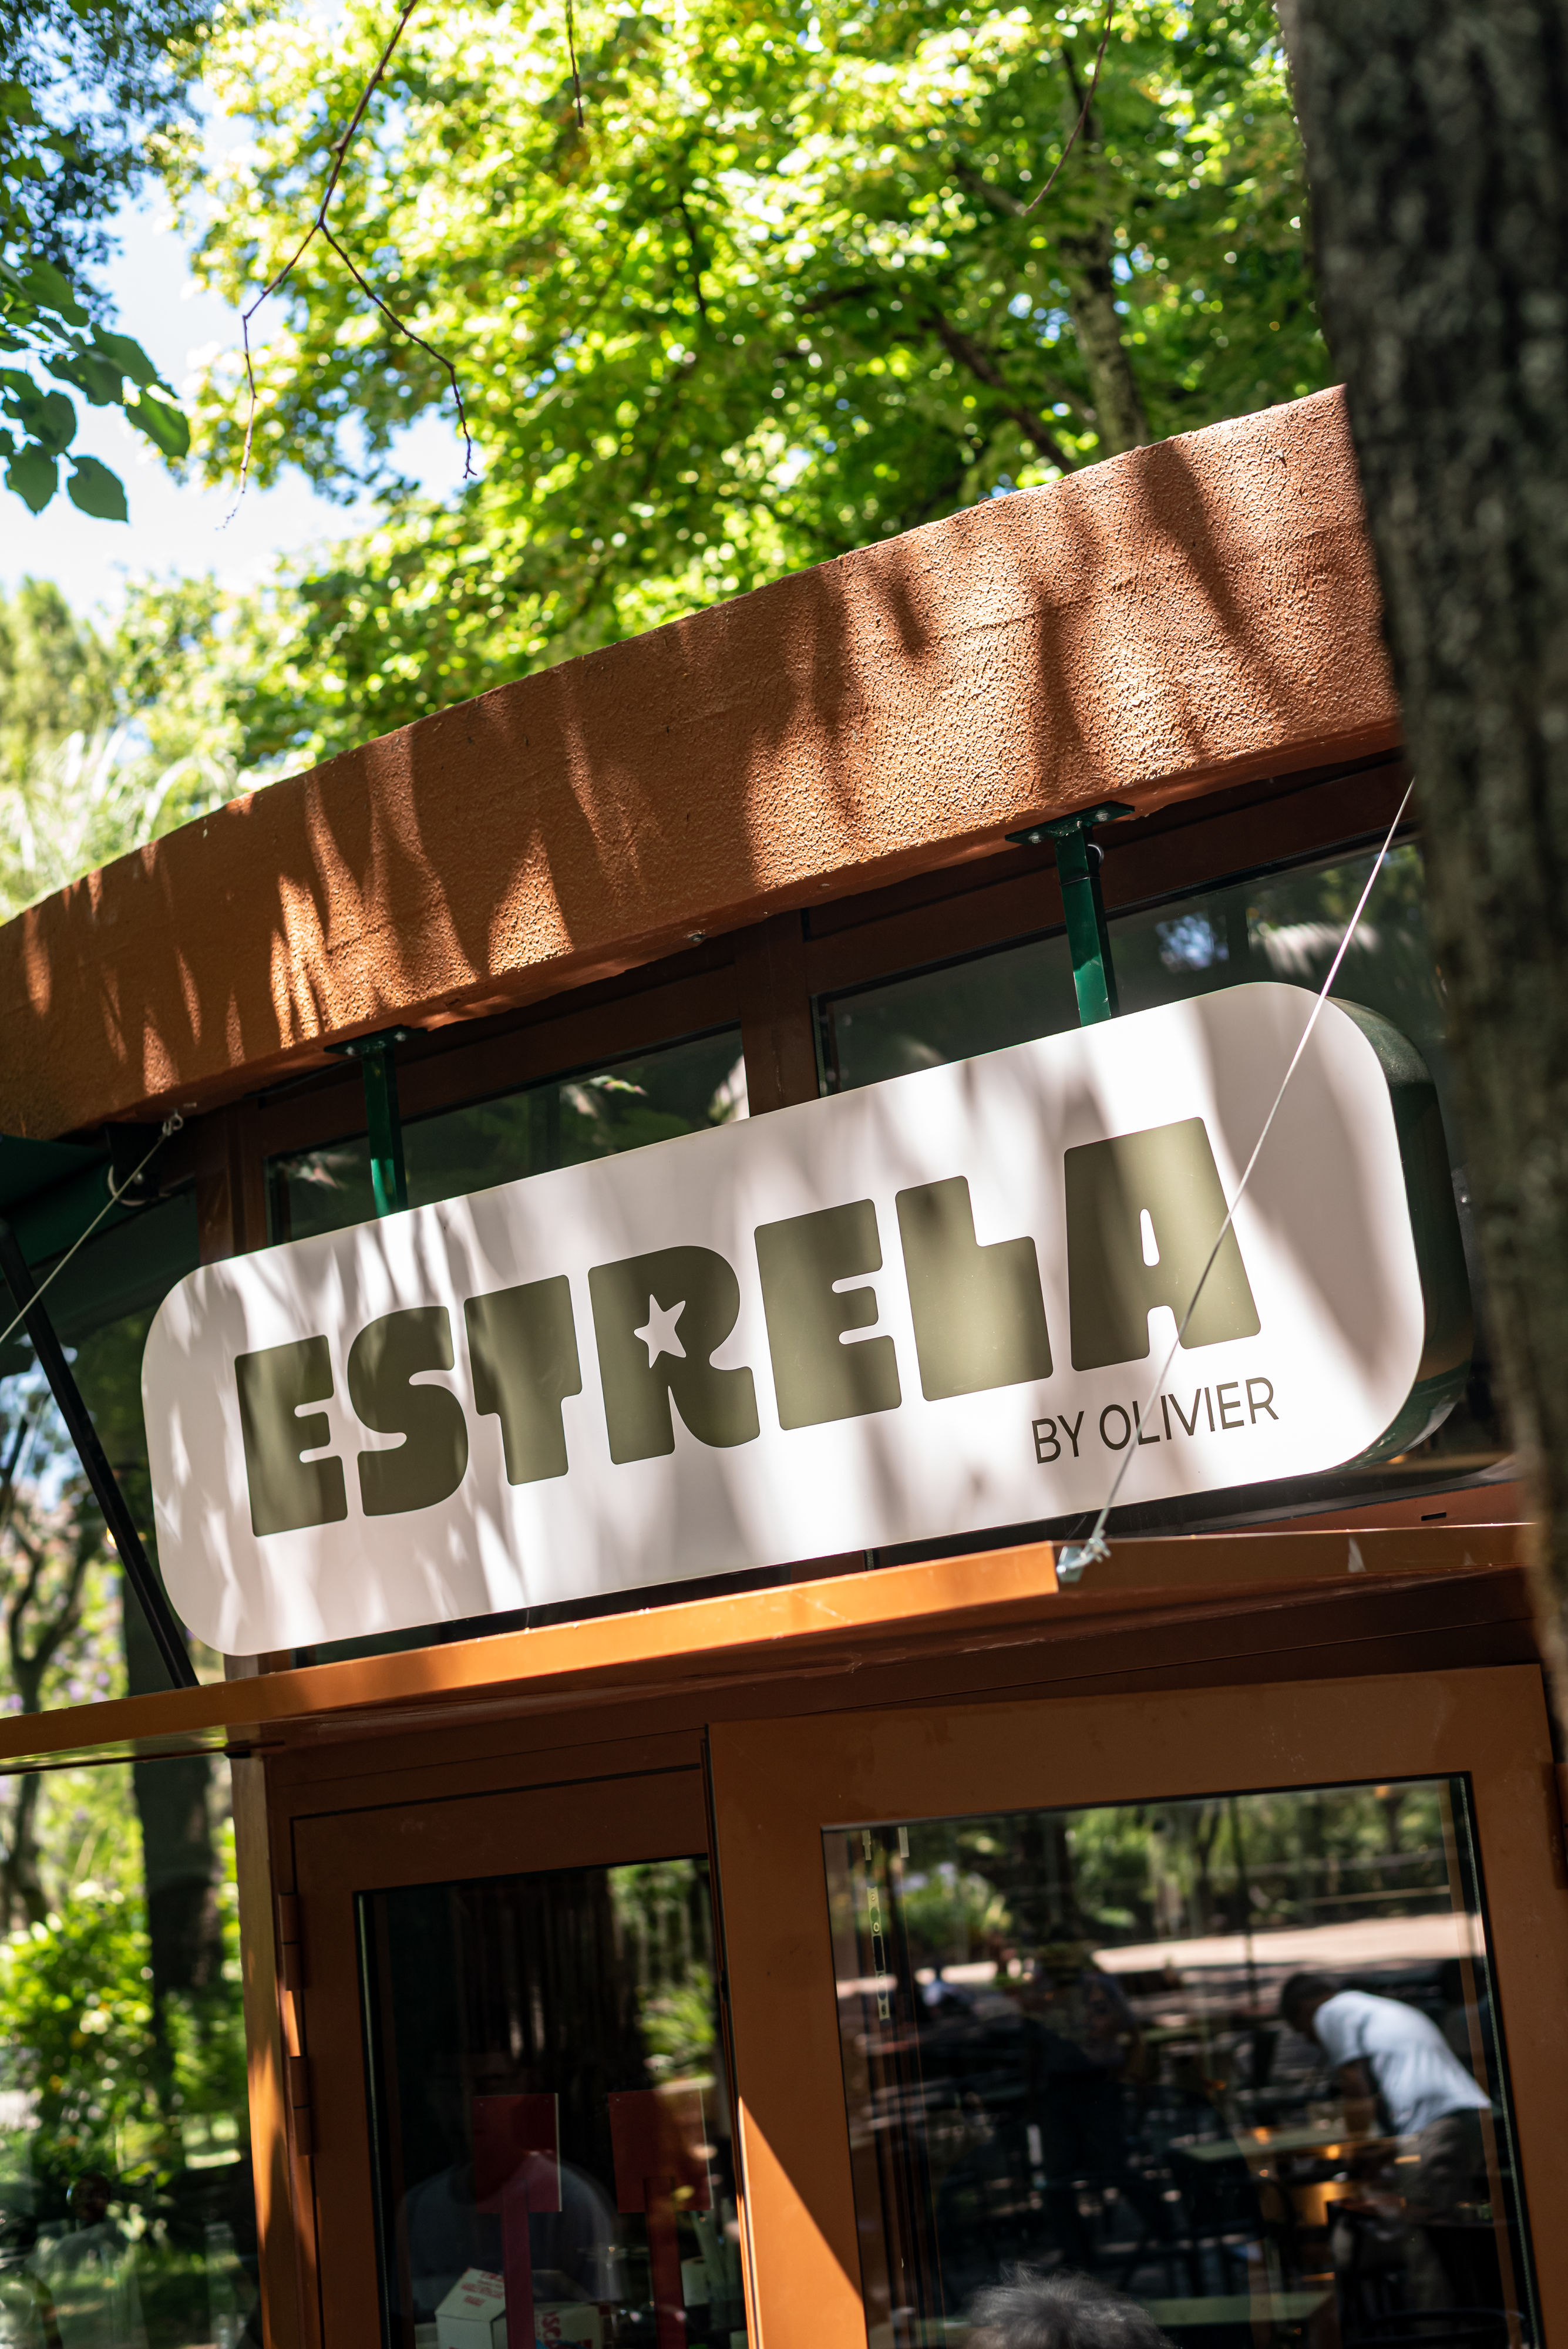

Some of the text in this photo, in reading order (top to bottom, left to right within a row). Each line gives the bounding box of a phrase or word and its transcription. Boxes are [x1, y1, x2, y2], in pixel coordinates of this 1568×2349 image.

[235, 1117, 1261, 1537] ESTRELA
[1032, 1377, 1279, 1464] BY OLIVIER
